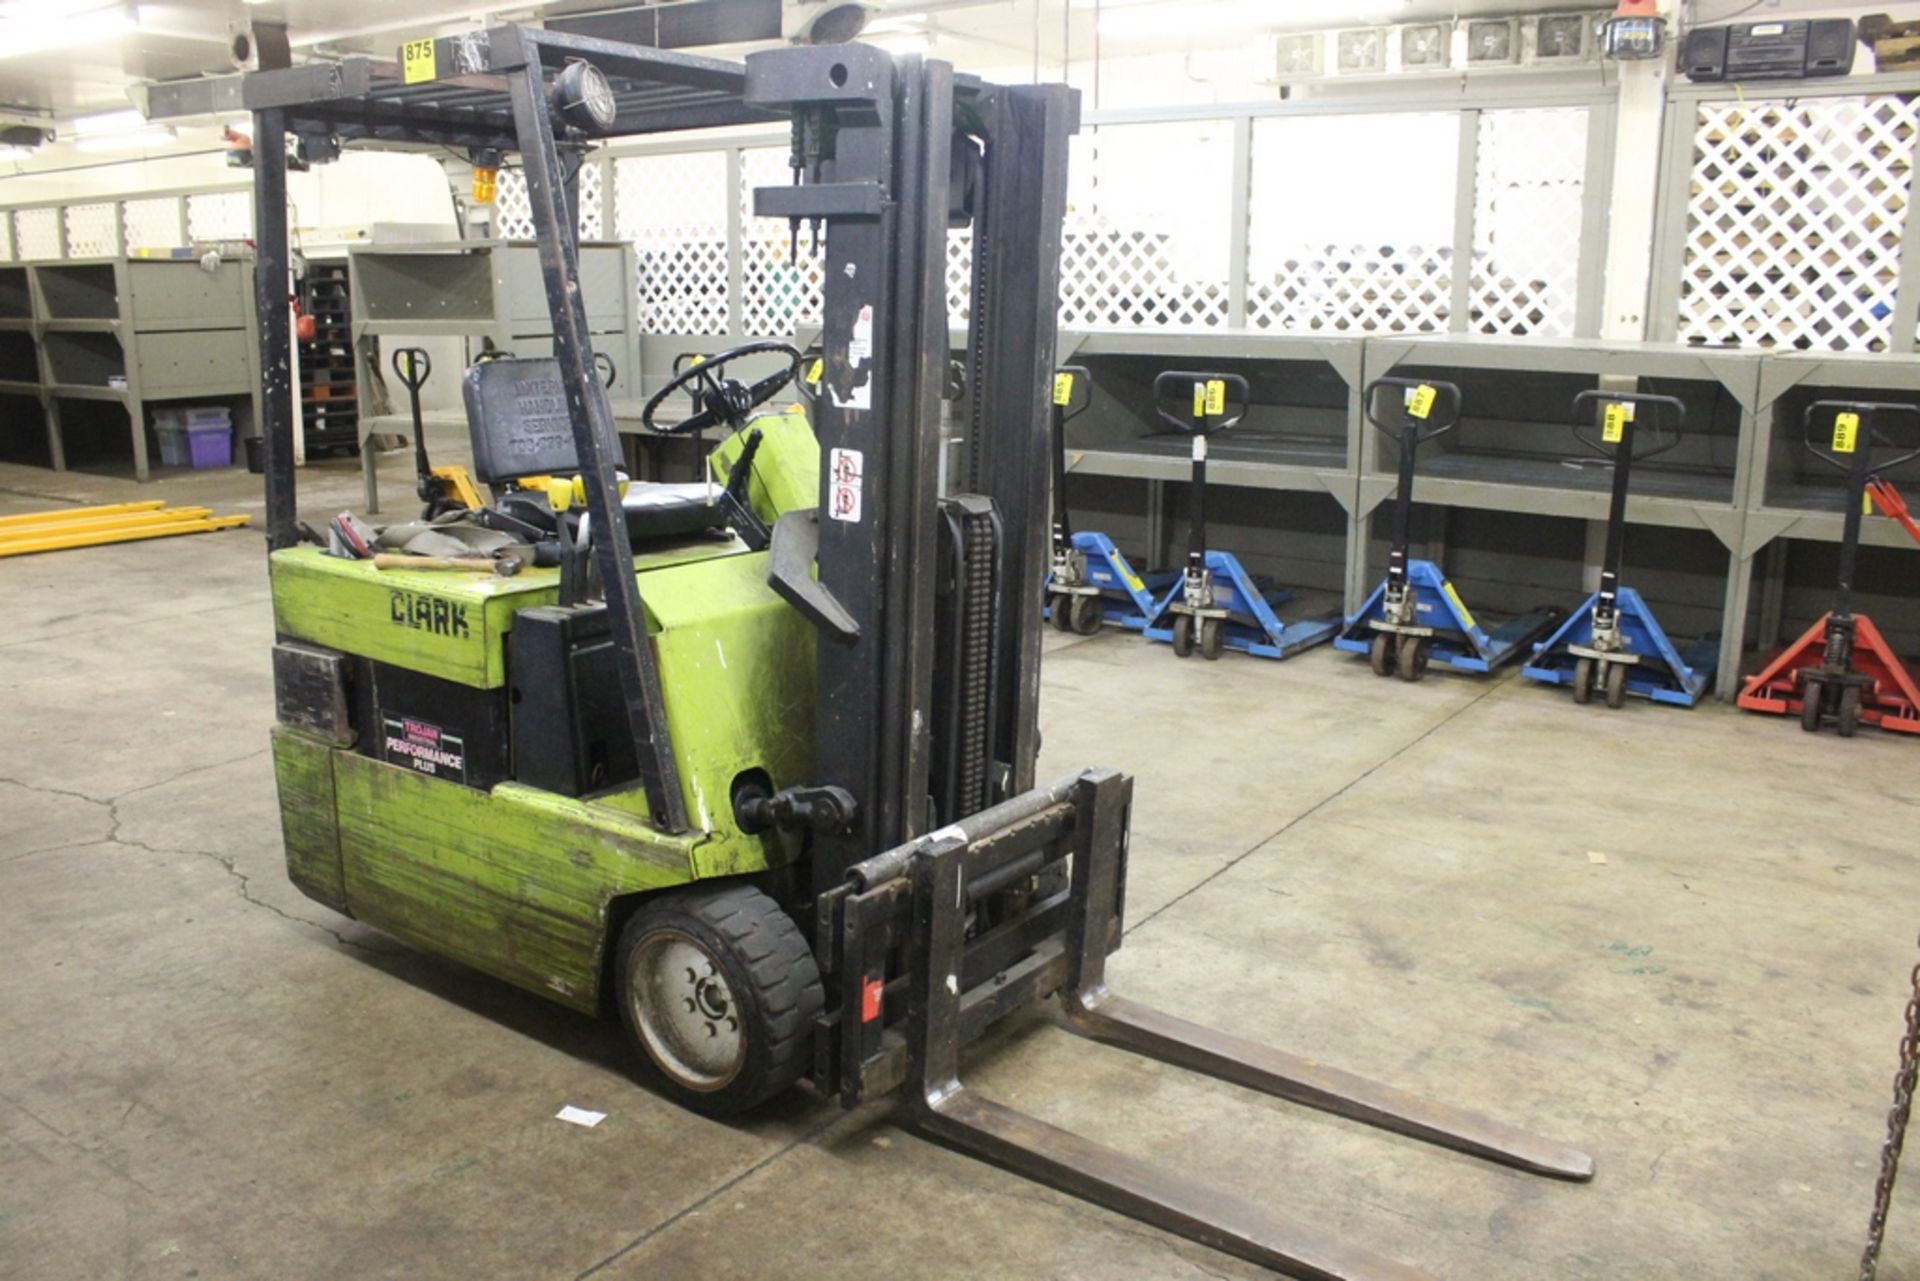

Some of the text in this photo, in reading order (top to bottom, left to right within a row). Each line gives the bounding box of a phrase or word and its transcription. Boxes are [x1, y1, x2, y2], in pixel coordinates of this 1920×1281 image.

[406, 40, 432, 61] 875
[391, 590, 470, 639] CLARK
[404, 720, 438, 738] TROJAN
[386, 737, 463, 769] PERFORMANCE
[413, 759, 436, 773] PLUS
